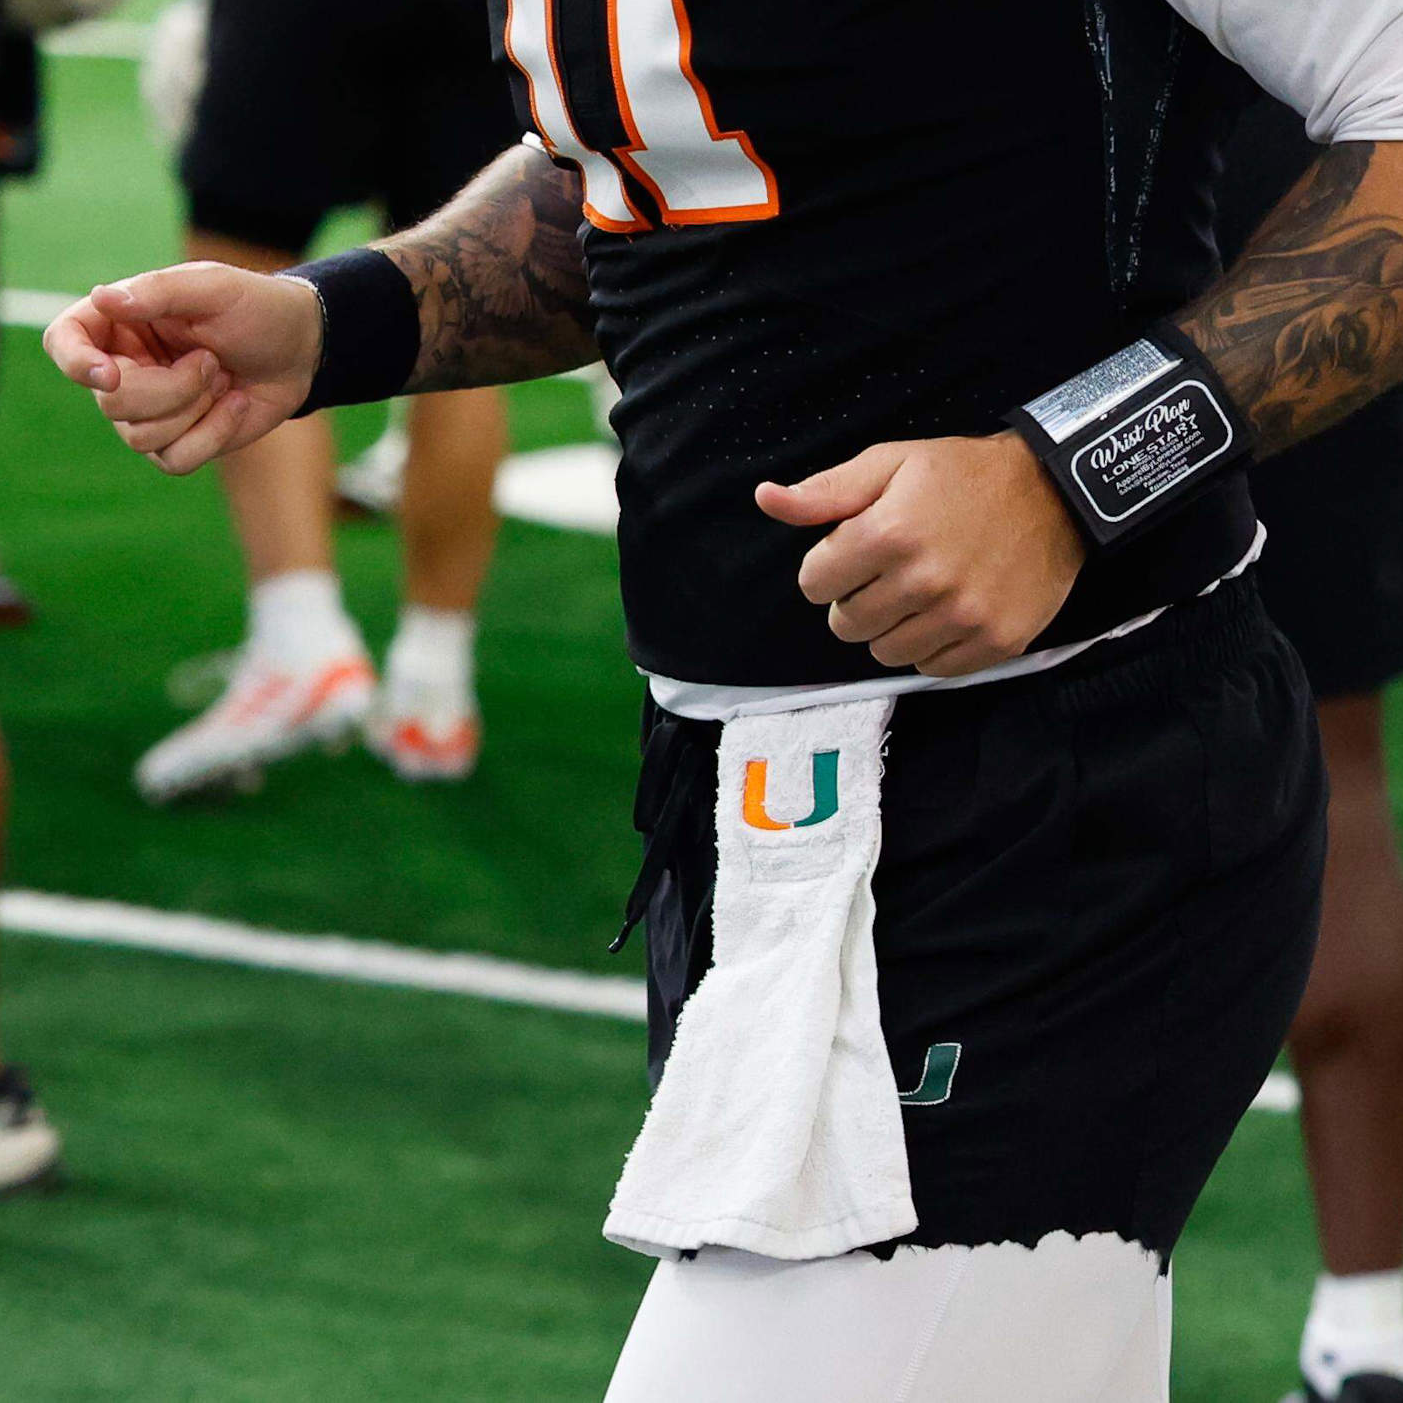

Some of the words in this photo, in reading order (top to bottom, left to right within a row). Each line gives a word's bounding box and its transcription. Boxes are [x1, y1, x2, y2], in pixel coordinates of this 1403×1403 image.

[1090, 424, 1145, 469] Wrist
[1144, 398, 1190, 433] Plan
[742, 748, 840, 832] U
